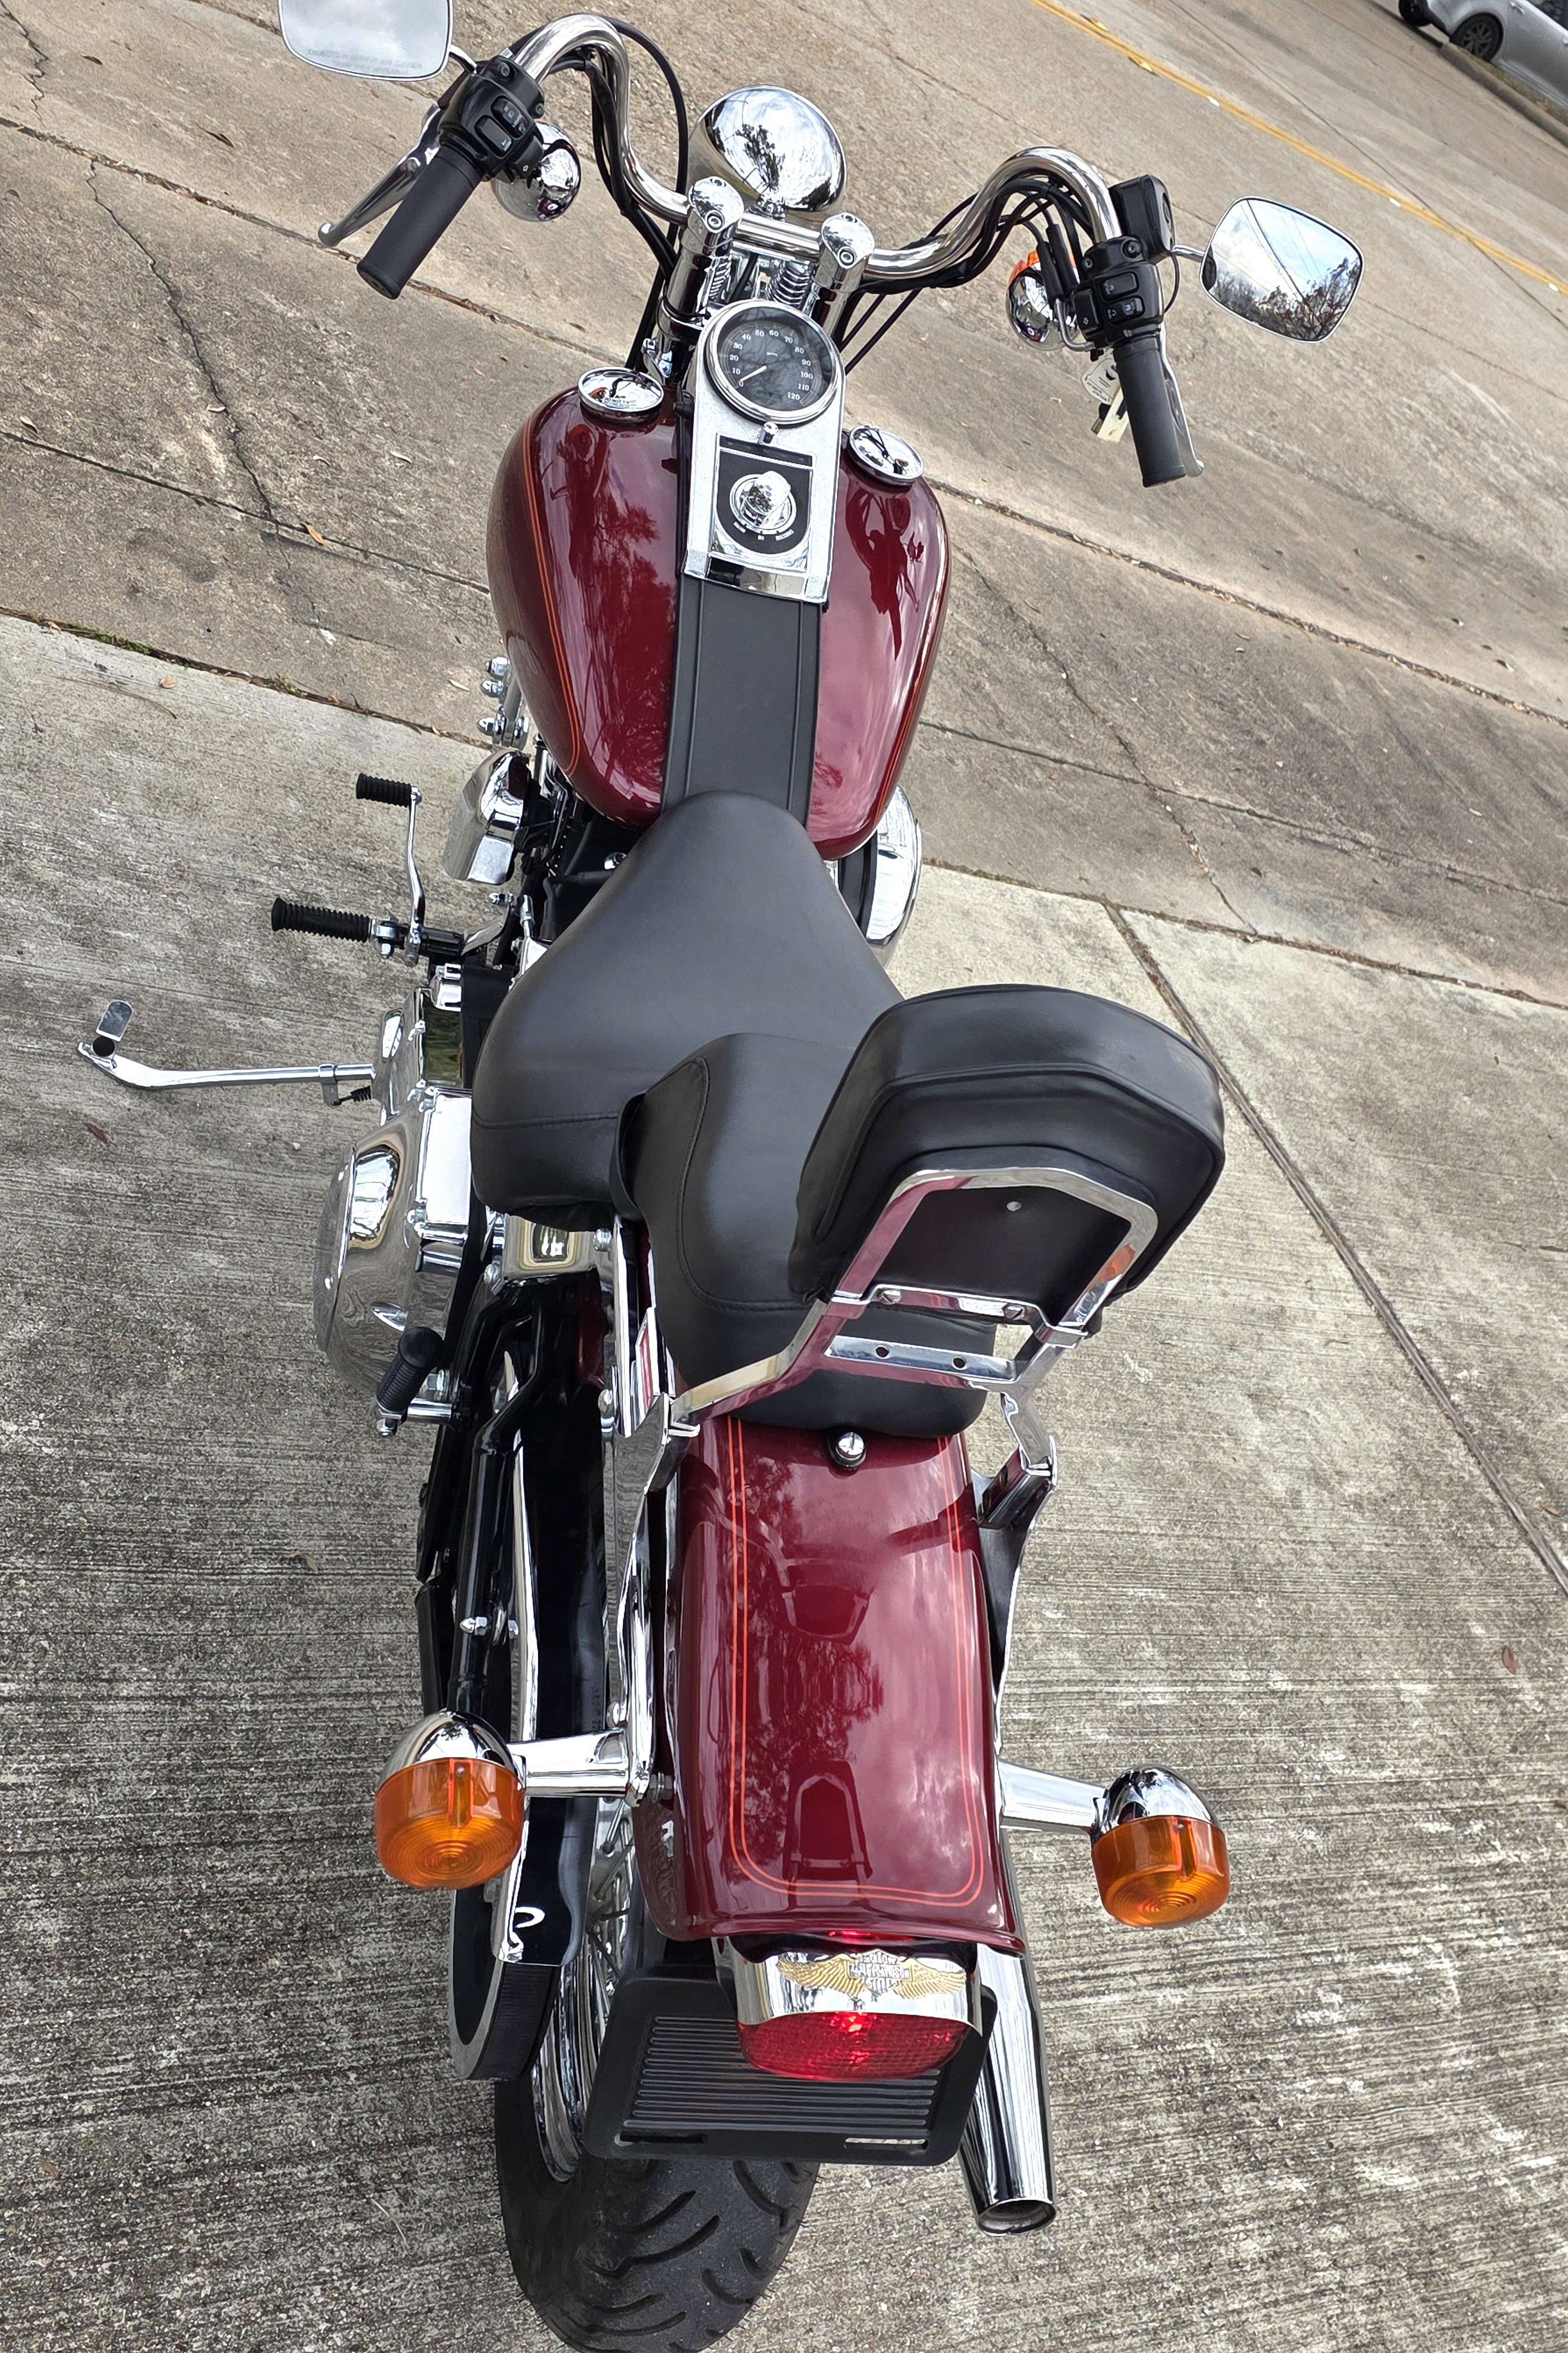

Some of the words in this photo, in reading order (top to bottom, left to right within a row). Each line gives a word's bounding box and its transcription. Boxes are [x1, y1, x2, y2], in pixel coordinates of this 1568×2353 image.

[800, 371, 813, 379] 100
[798, 383, 809, 391] 110
[788, 392, 800, 400] 120
